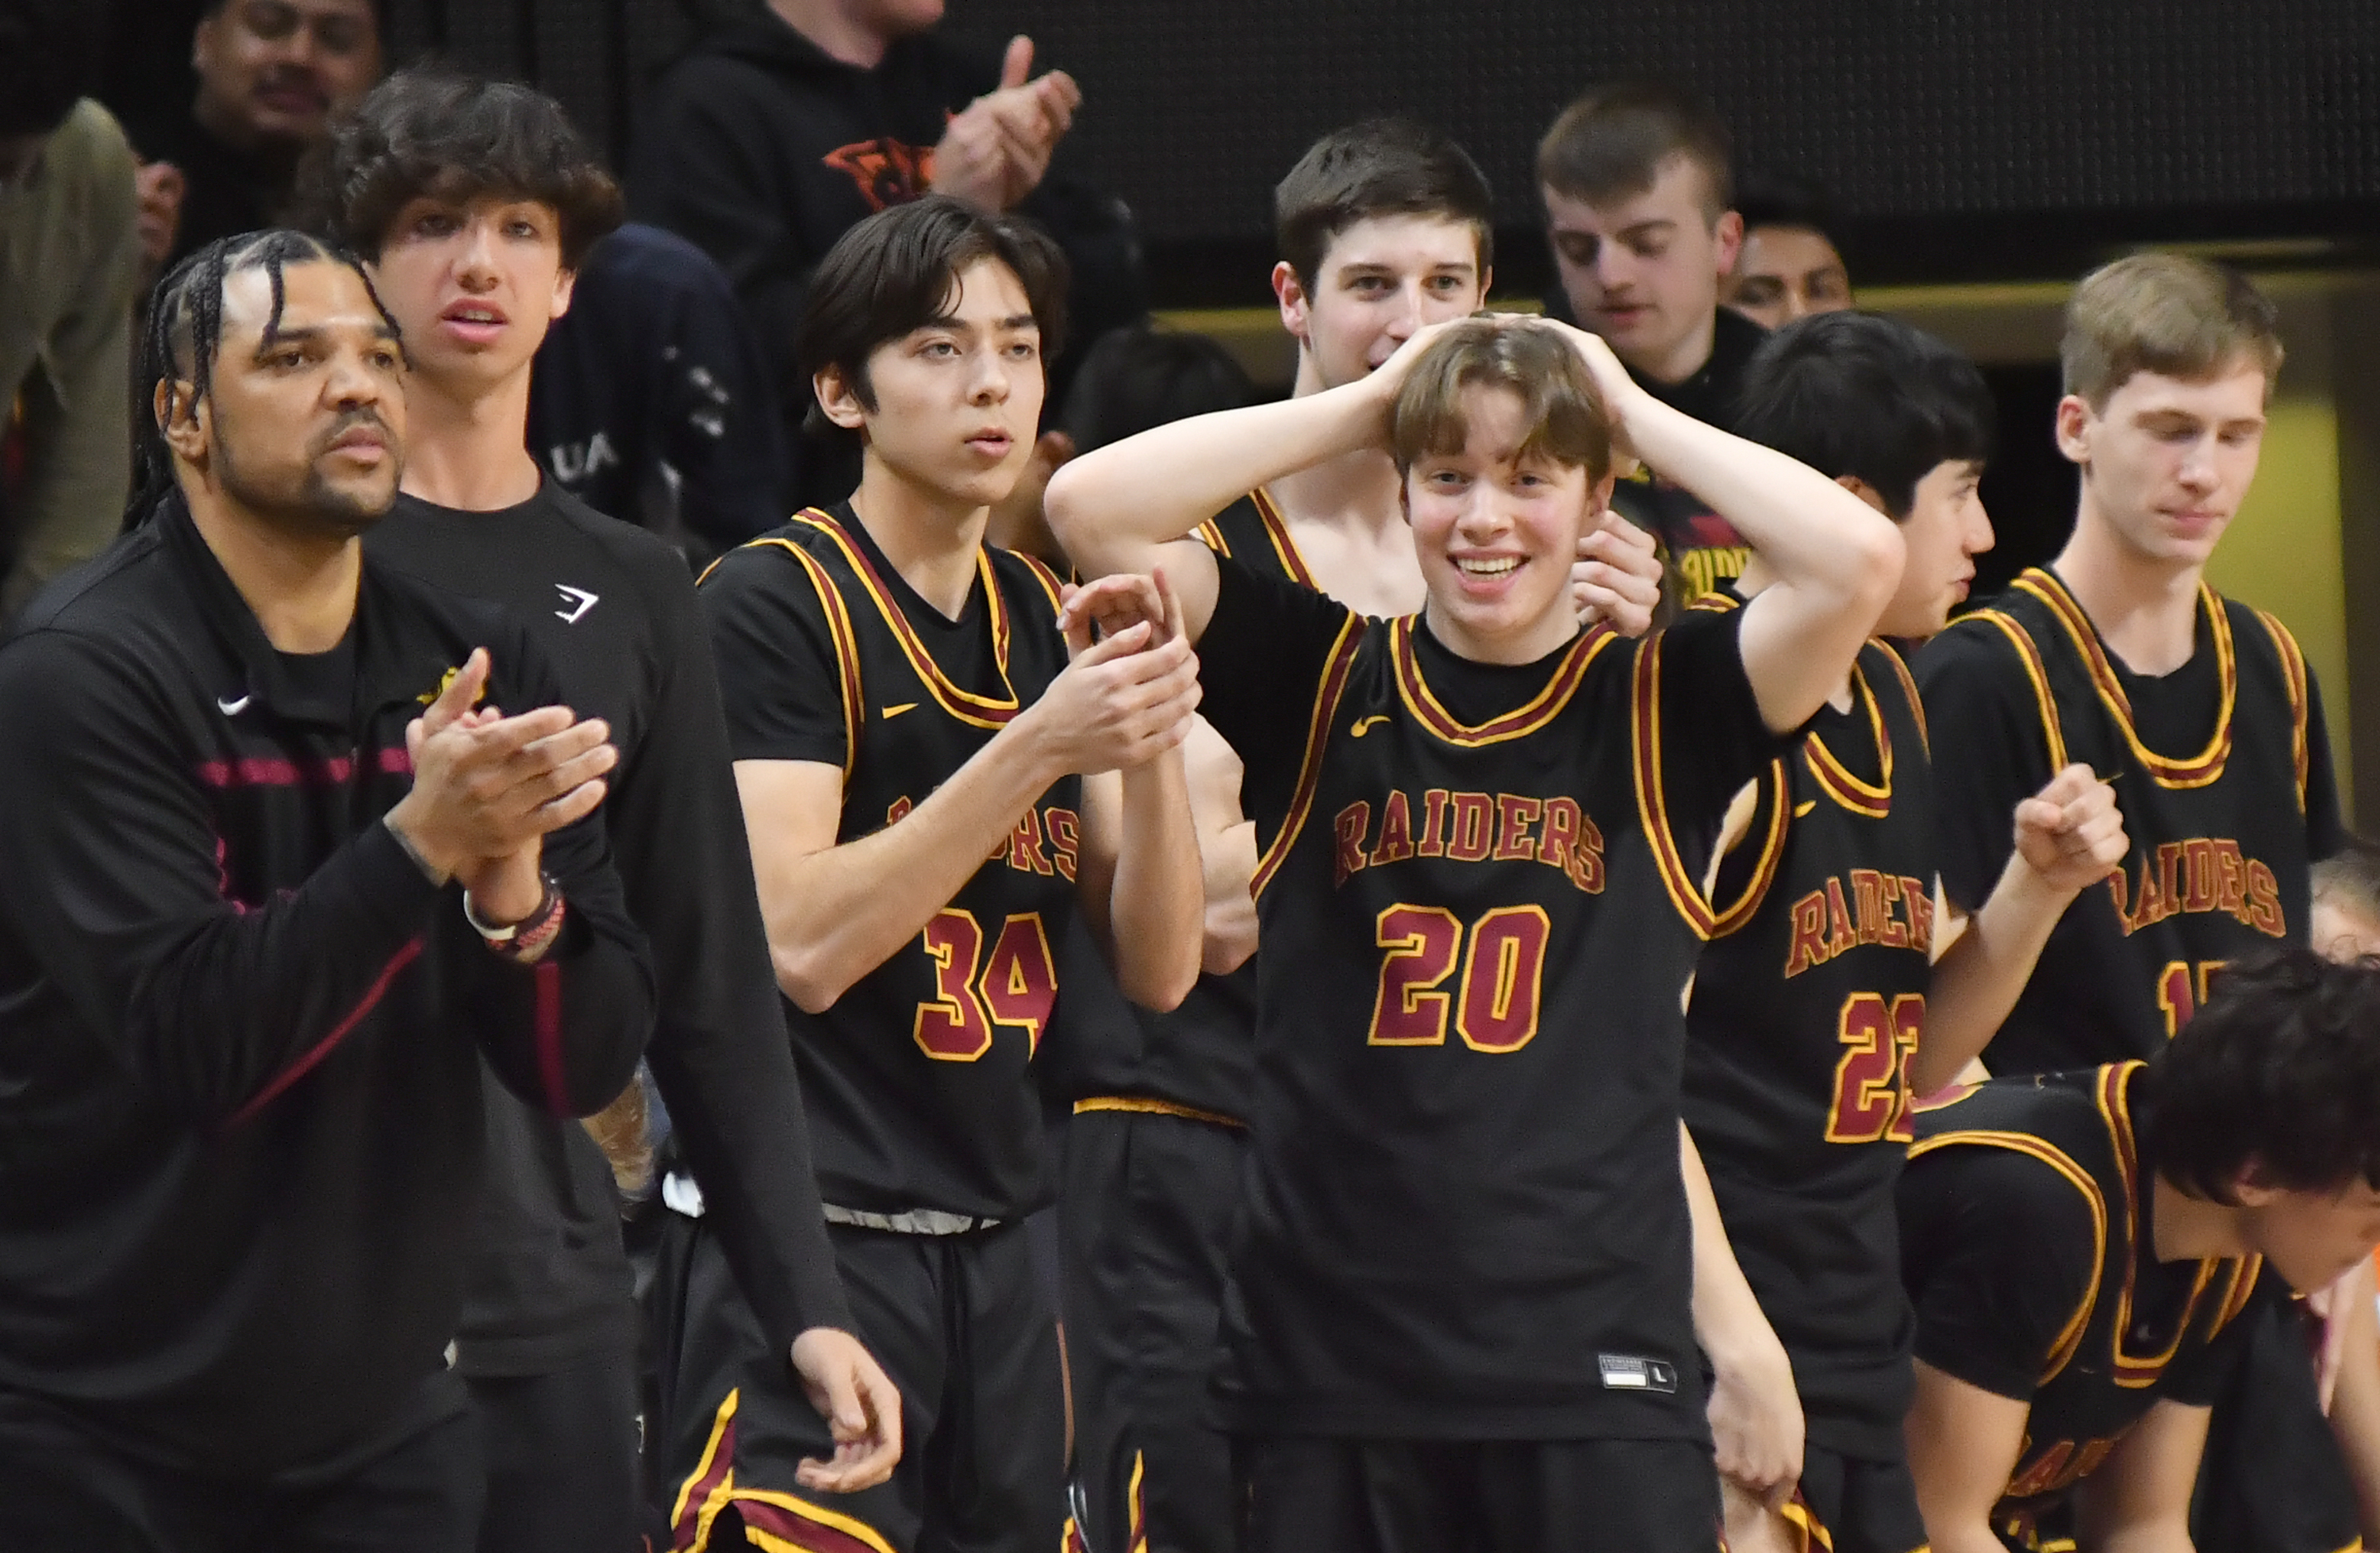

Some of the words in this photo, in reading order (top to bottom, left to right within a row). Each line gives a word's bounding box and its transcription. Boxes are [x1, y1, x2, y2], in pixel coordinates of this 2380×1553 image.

[1334, 790, 1604, 894] RAIDERS
[913, 908, 1058, 1062] 34
[1367, 903, 1550, 1053] 20
